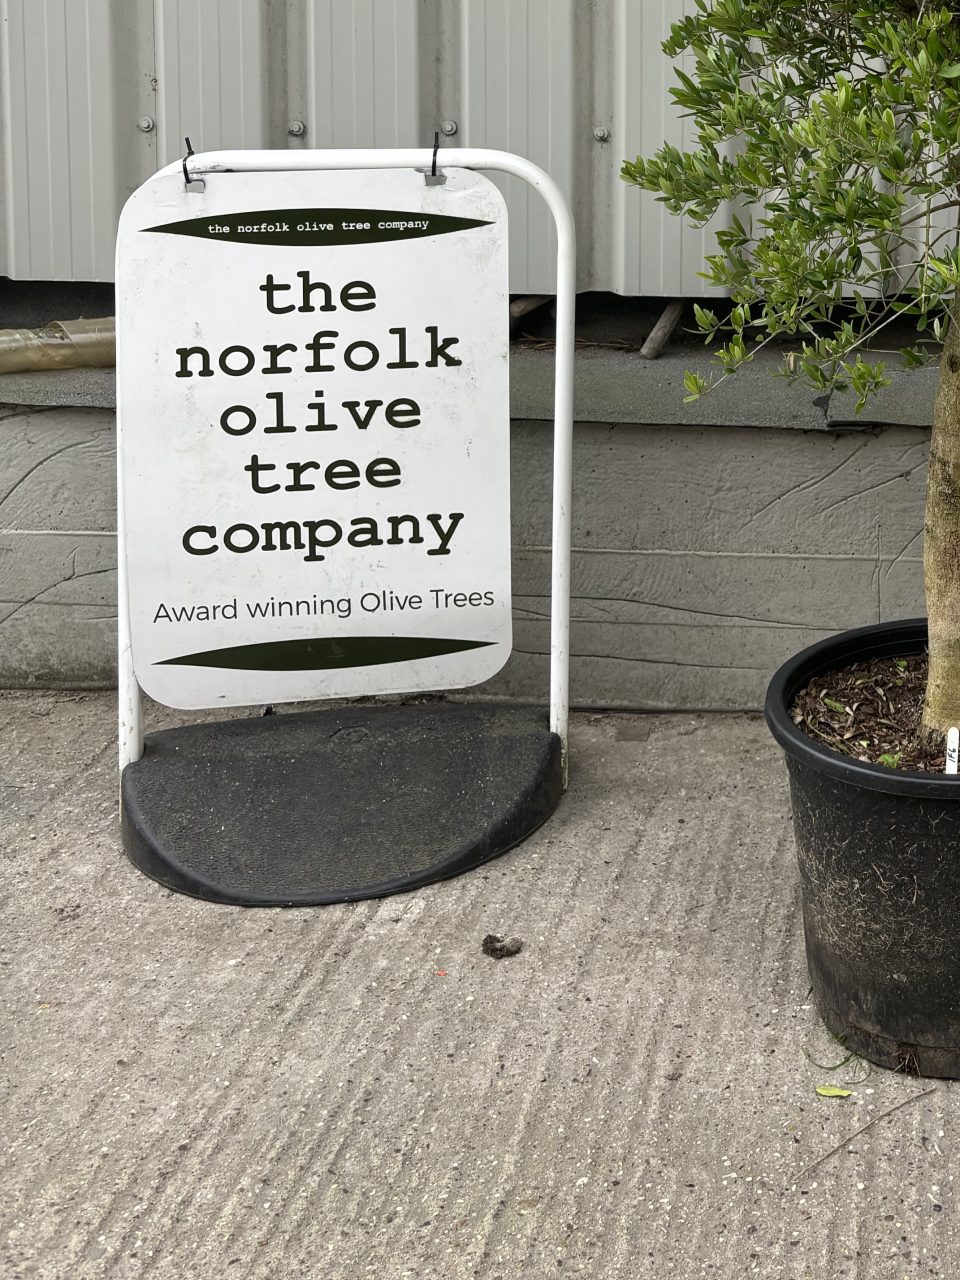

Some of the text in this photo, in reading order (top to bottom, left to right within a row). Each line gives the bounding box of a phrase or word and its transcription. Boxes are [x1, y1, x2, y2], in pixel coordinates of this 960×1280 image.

[207, 219, 430, 234] the norfolk olive tree company
[259, 270, 377, 314] the
[175, 326, 462, 378] norfolk
[219, 390, 421, 436] olive
[243, 454, 401, 494] tree
[182, 512, 465, 562] company
[153, 589, 495, 624] Award winning Olive Trees
